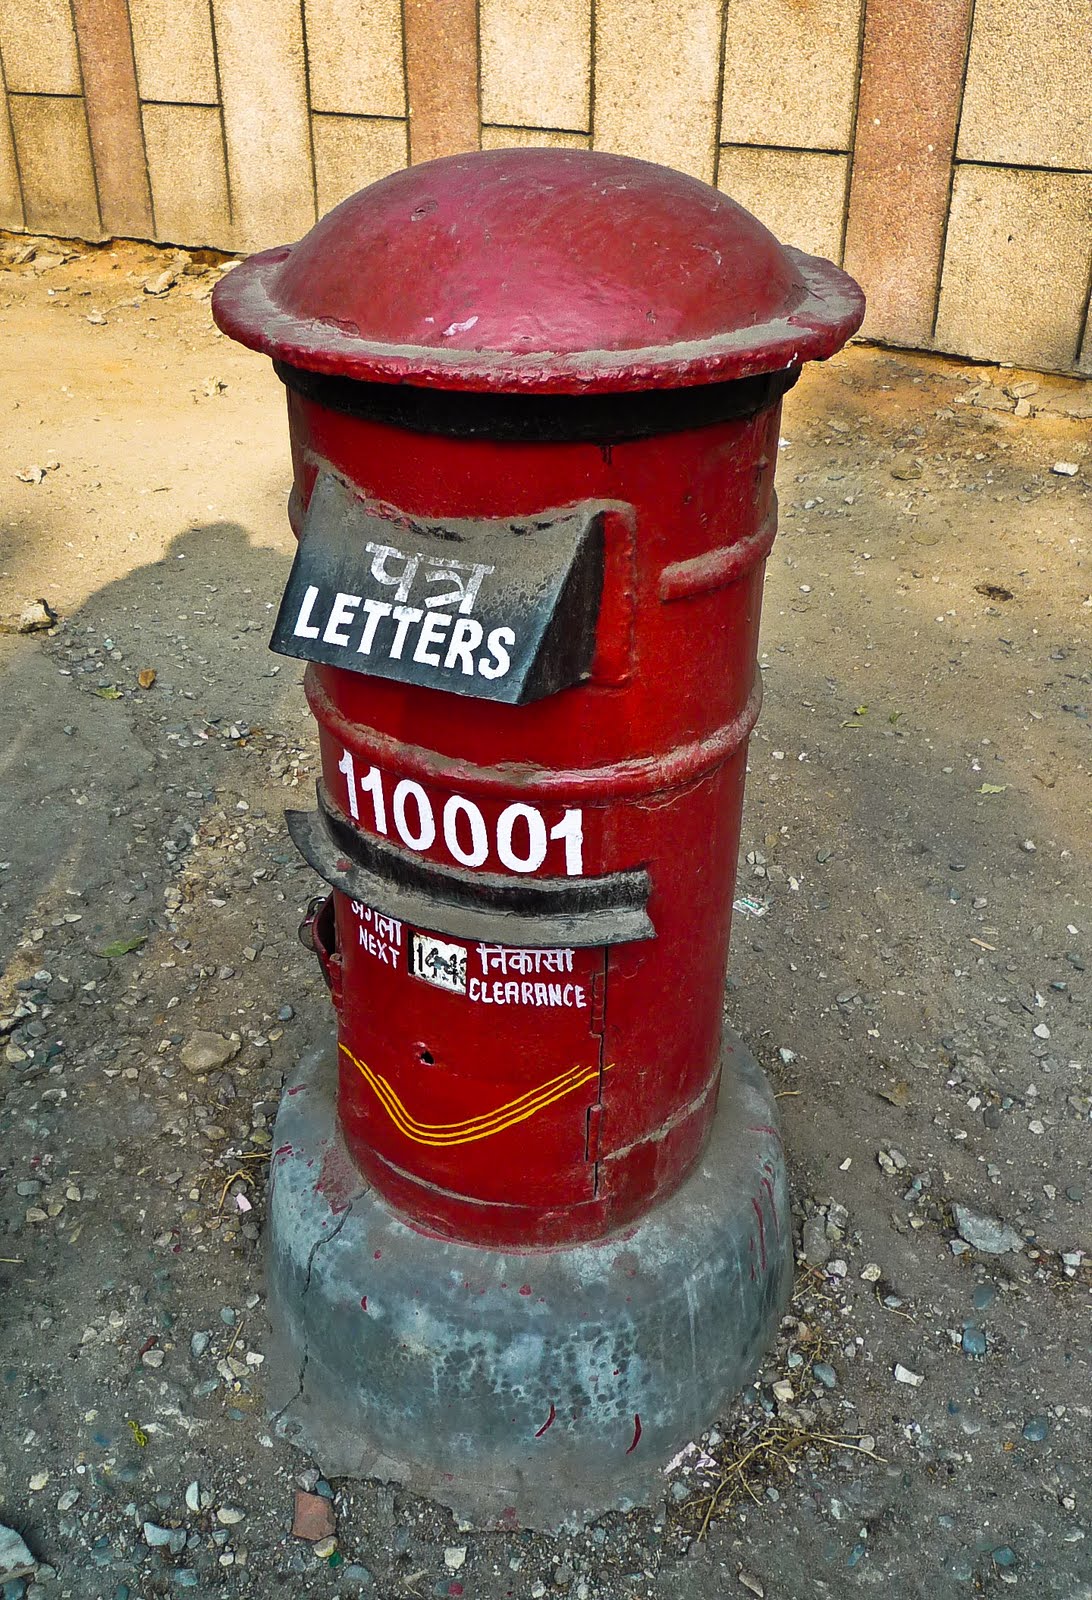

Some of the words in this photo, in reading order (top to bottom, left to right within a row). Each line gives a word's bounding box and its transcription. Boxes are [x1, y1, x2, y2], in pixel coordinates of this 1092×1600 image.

[365, 541, 495, 614] पत्र
[293, 585, 516, 680] LETTERS
[339, 749, 583, 876] 110001
[359, 925, 400, 969] NEXT
[469, 977, 587, 1009] CLEARANCE
